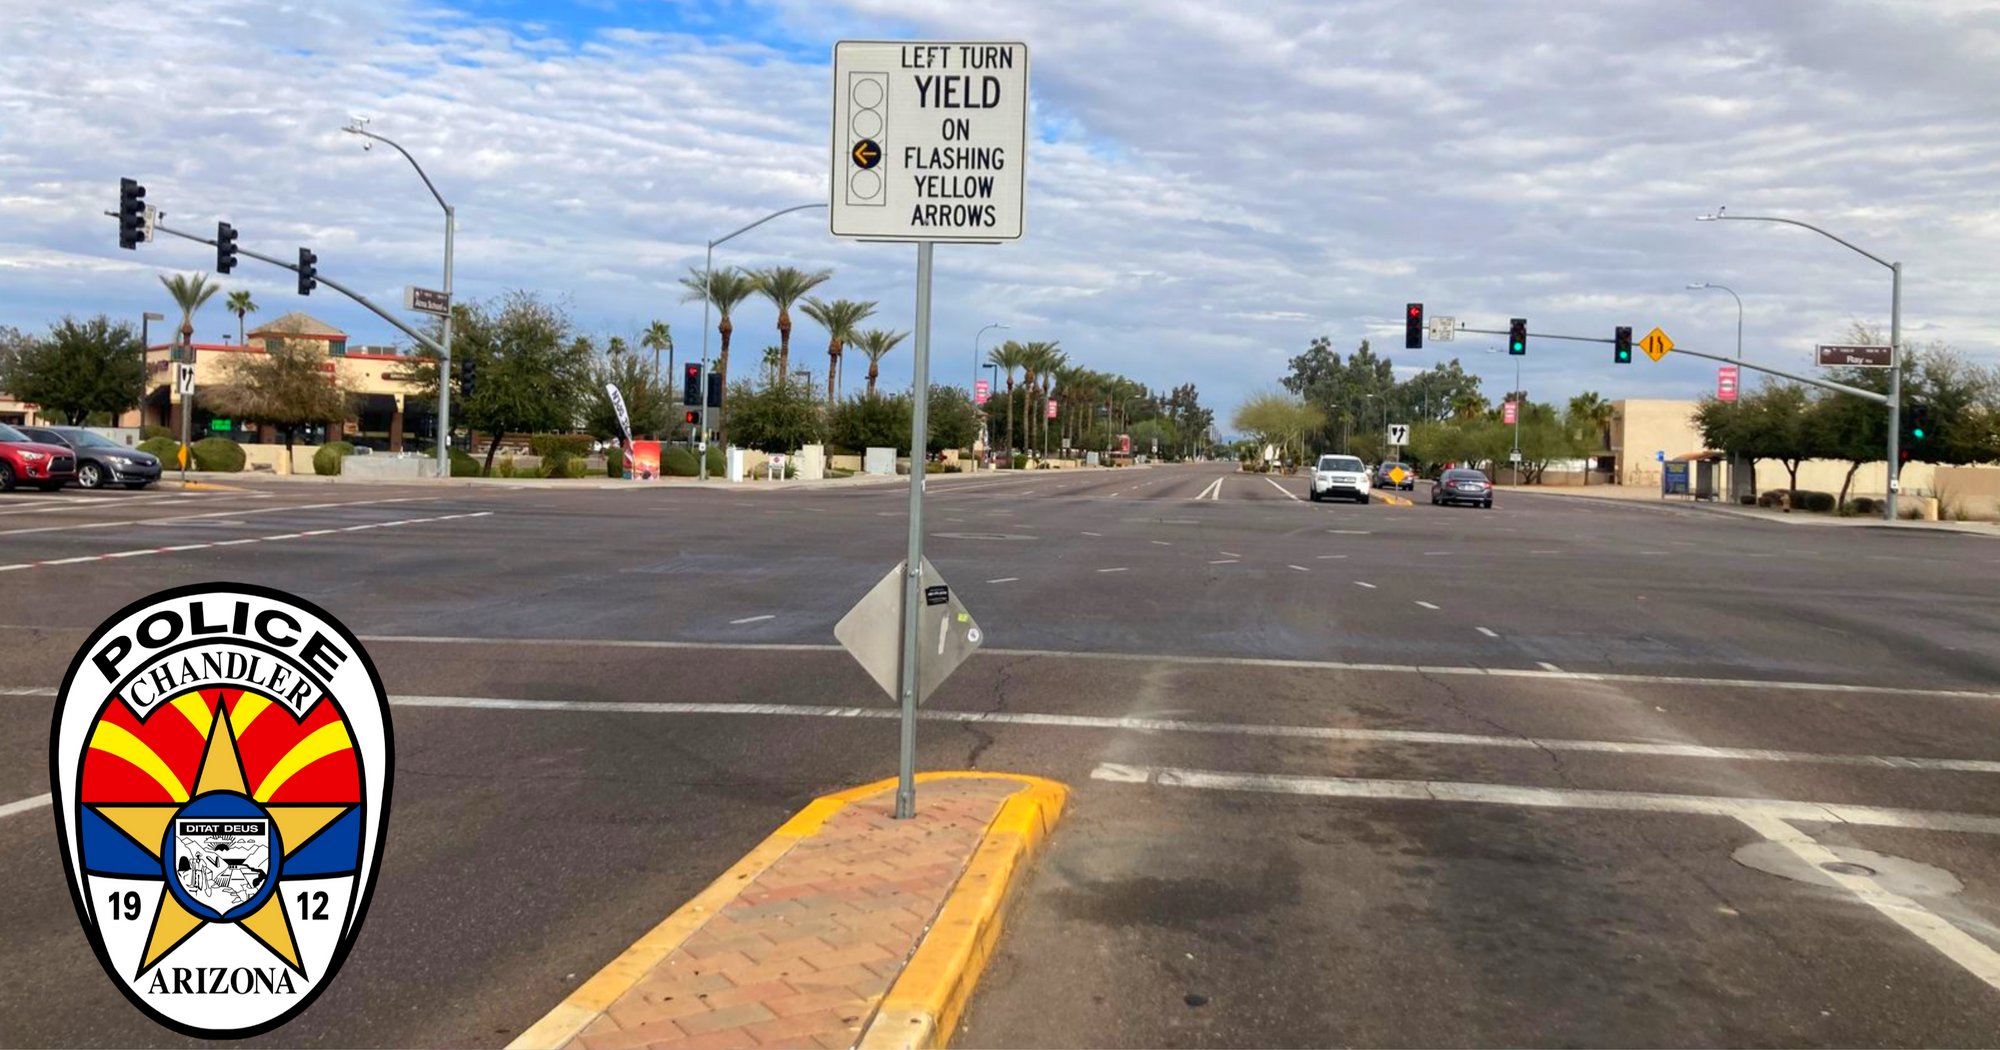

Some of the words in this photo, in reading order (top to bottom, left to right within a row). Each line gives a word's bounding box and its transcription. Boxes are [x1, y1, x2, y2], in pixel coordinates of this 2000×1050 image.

[902, 46, 951, 69] LEFT
[960, 47, 1012, 69] TURN
[914, 75, 1001, 109] YIELD
[942, 118, 970, 141] ON
[904, 147, 1005, 170] FLASHING
[914, 175, 994, 198] YELLOW
[911, 204, 996, 227] ARROWS
[1847, 355, 1864, 365] Ray
